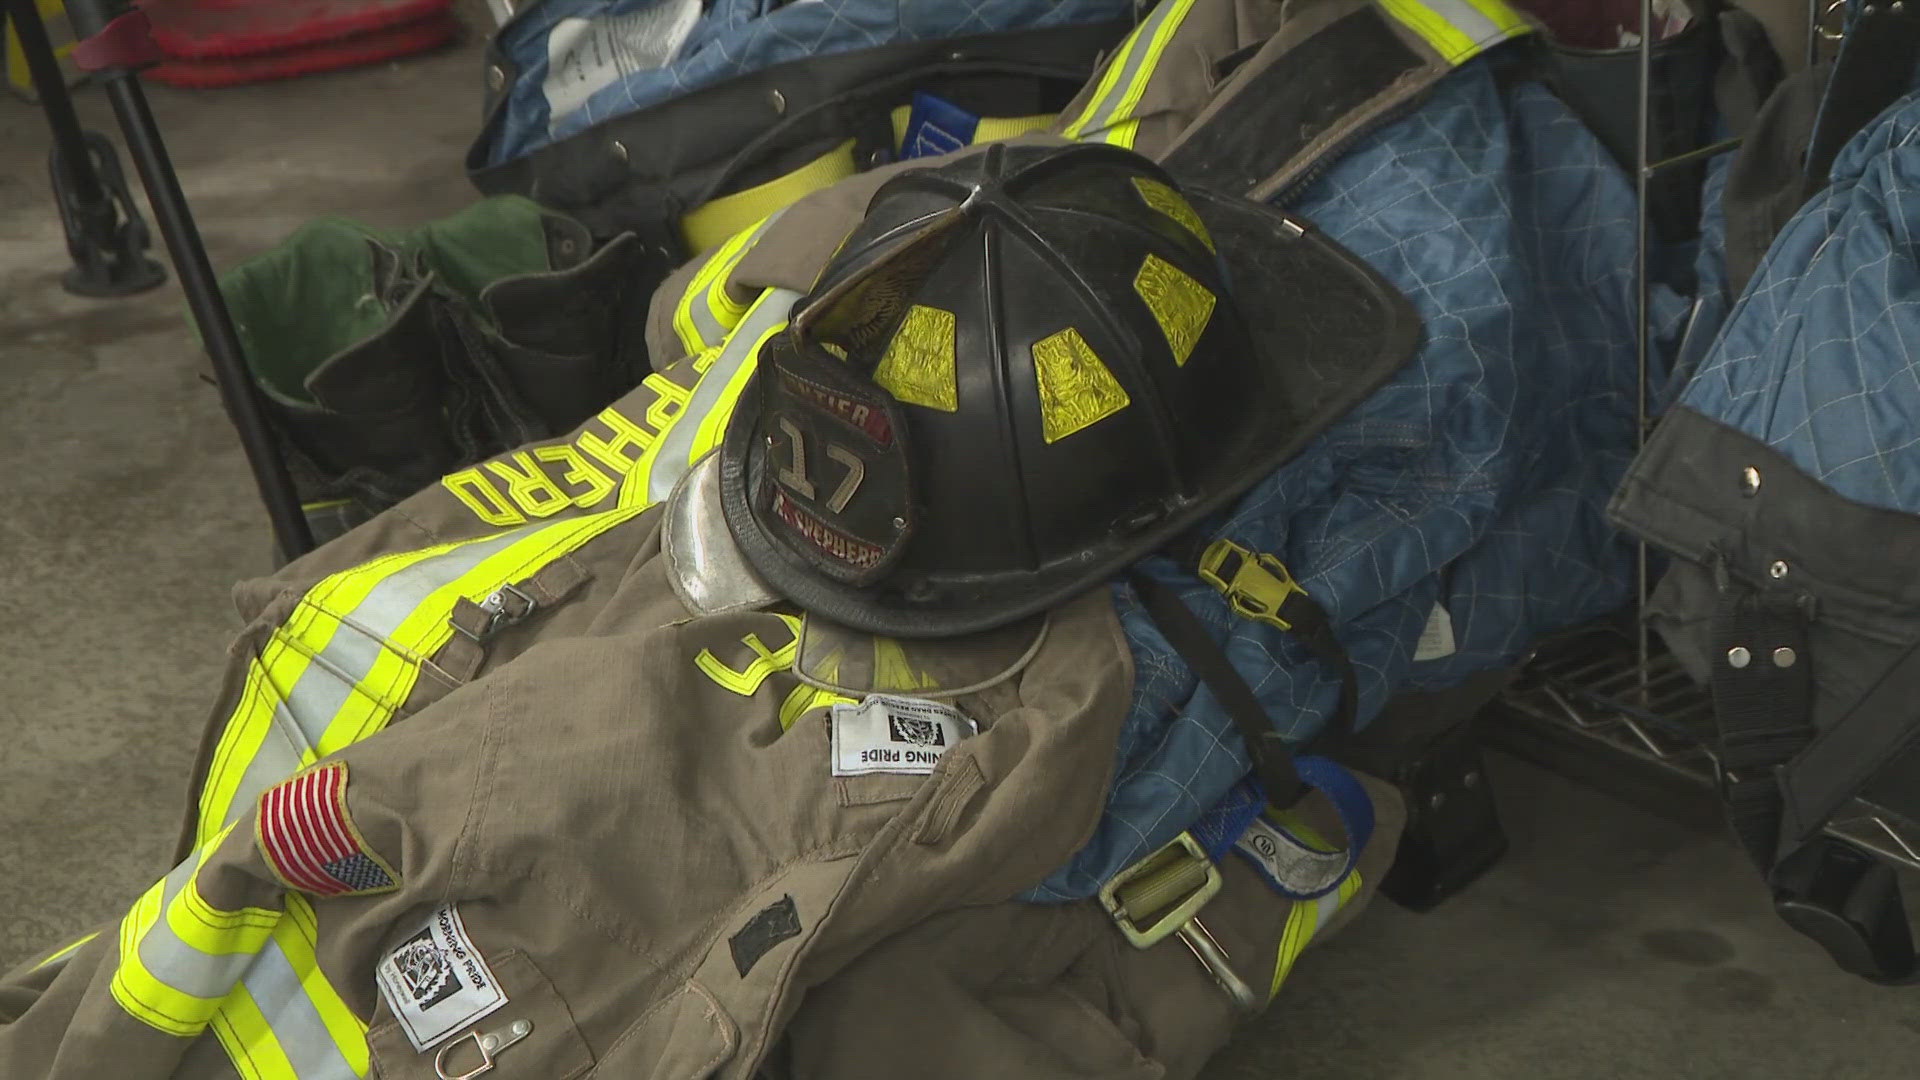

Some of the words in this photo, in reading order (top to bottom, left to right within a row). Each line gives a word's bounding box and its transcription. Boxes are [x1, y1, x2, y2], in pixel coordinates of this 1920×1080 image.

[779, 416, 865, 515] 17
[861, 749, 900, 763] PRIDE
[463, 959, 487, 991] PRIDE
